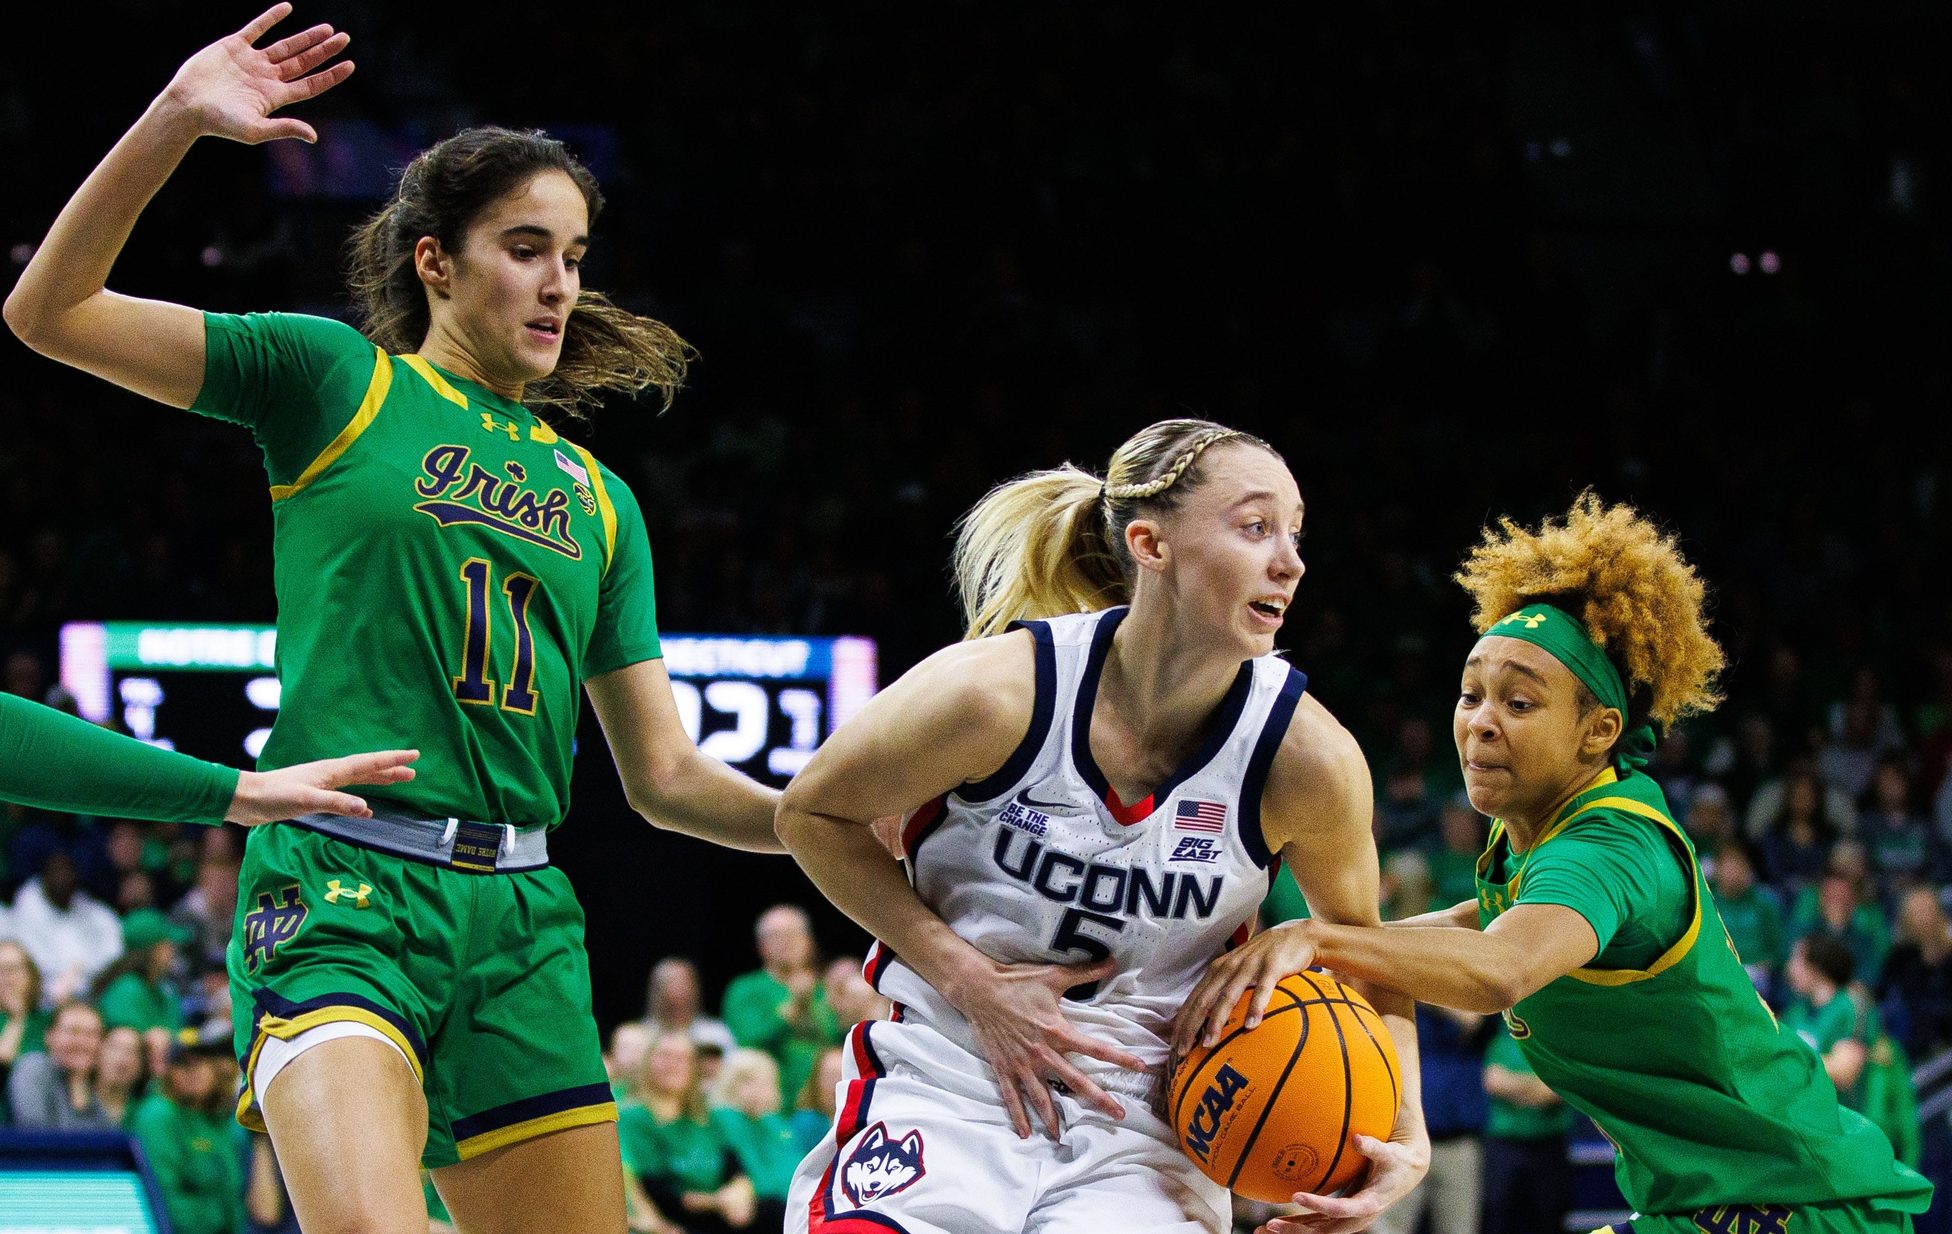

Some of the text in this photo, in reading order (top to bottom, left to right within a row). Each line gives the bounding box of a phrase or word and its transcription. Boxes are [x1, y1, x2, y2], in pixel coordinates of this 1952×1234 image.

[414, 444, 581, 560] Irish
[453, 556, 540, 716] 11
[999, 811, 1048, 837] CHANGE
[1007, 802, 1050, 827] BE THE
[1178, 836, 1216, 850] BIG
[992, 826, 1225, 920] UCONN
[1171, 846, 1223, 861] EAST
[1050, 907, 1128, 1001] 5
[1185, 1062, 1249, 1166] NCAA
[1235, 1086, 1257, 1112] BALL
